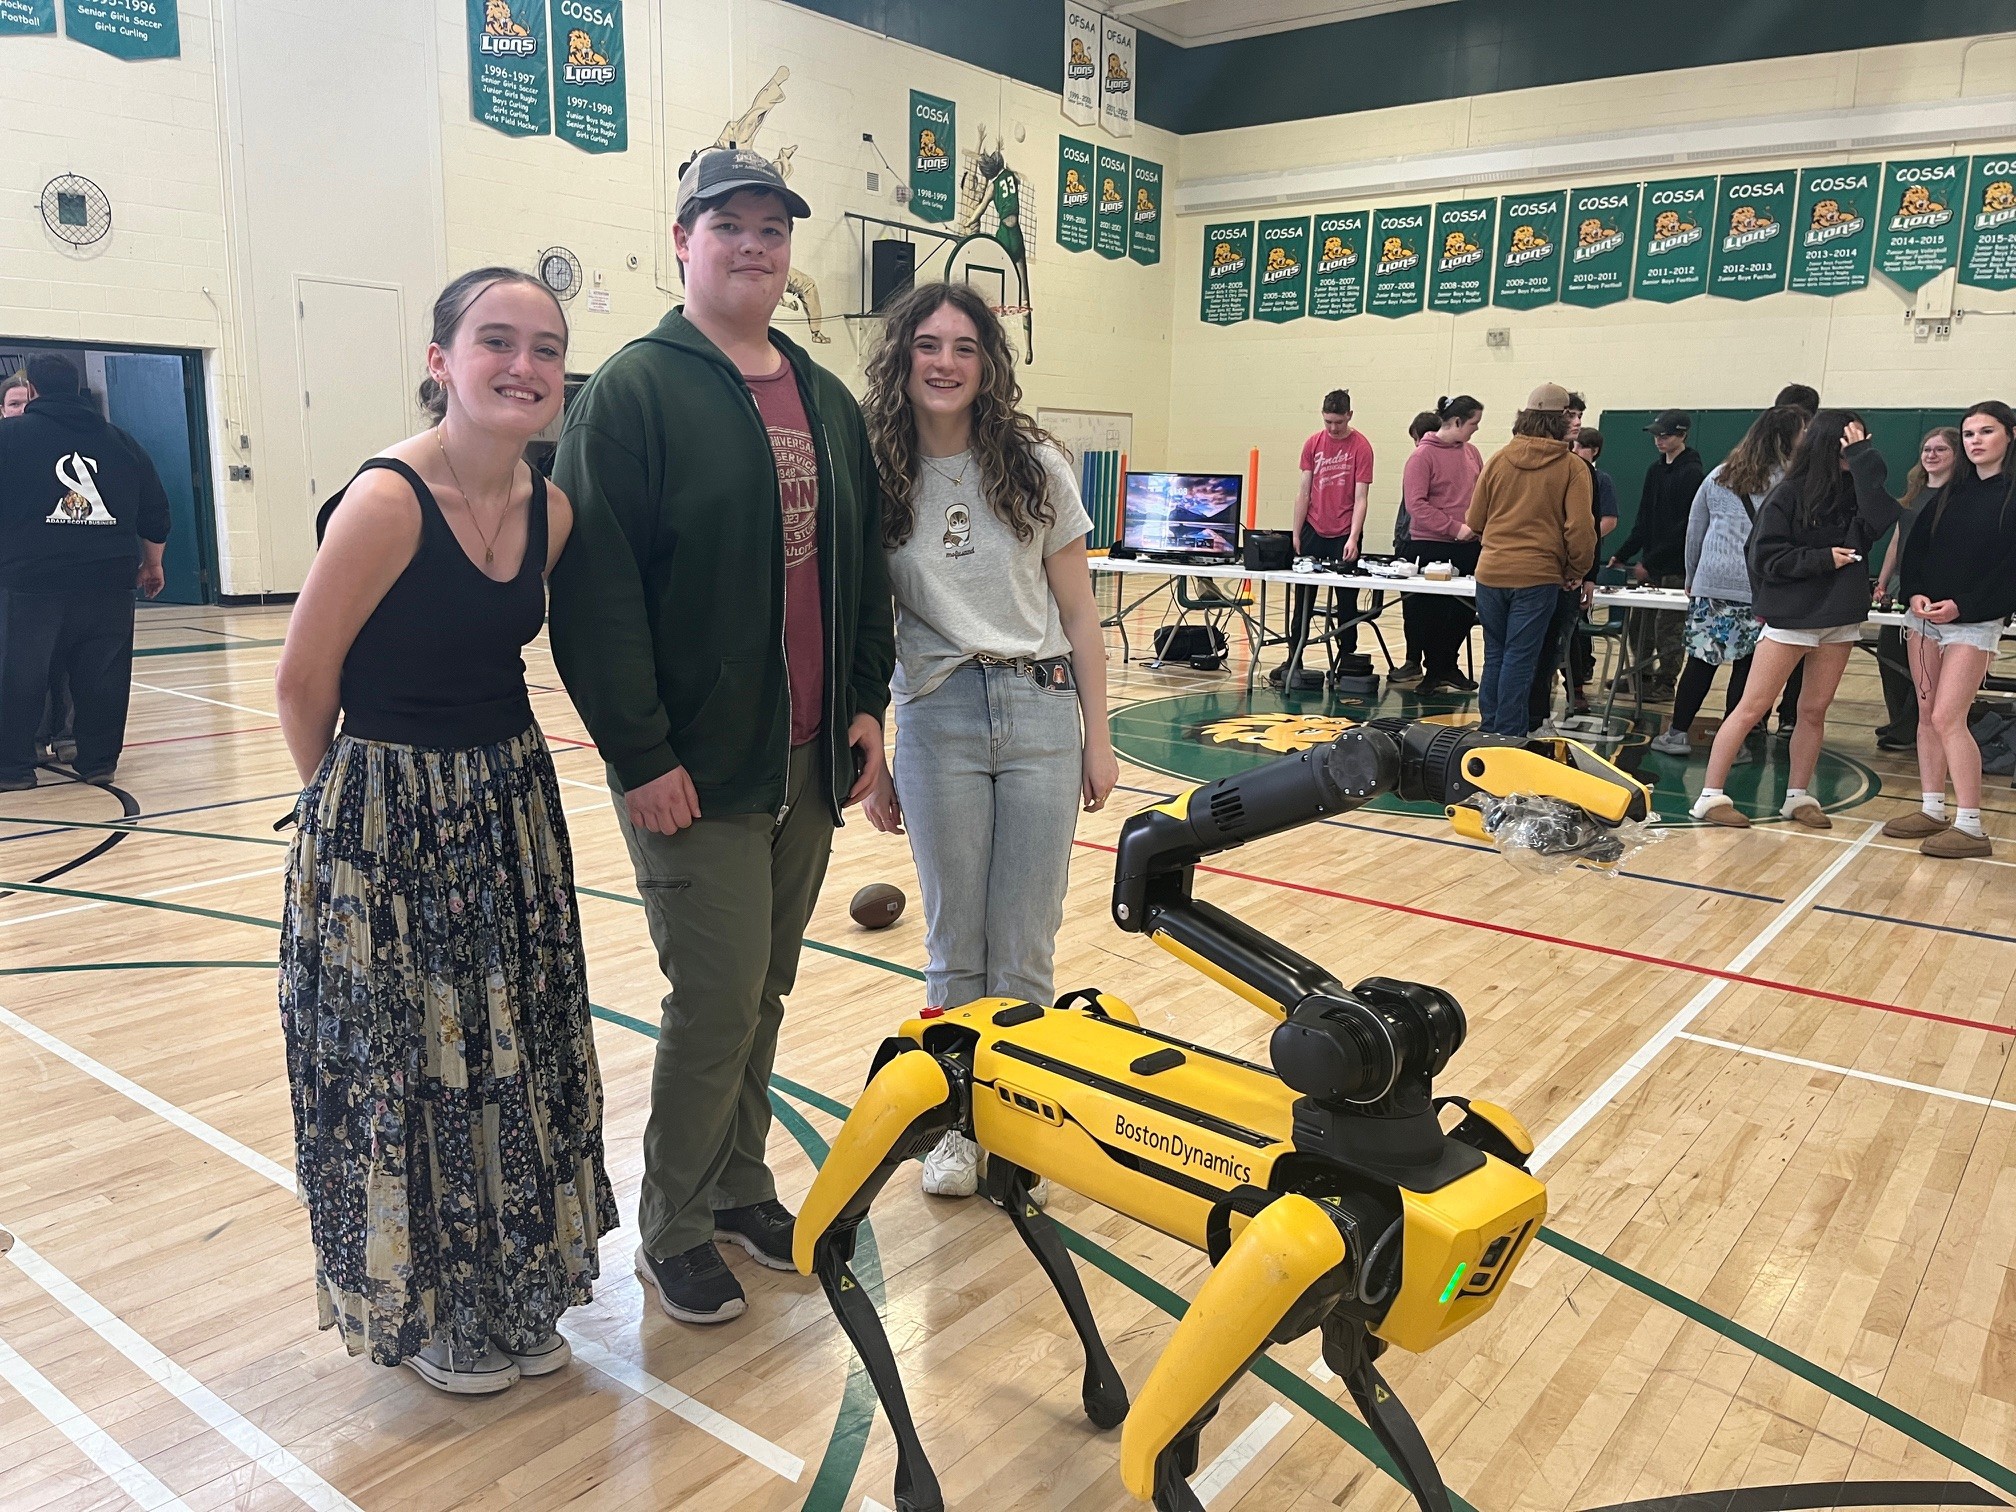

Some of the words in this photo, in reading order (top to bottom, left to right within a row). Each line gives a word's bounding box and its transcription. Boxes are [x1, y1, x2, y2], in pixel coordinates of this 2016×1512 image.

[2, 12, 40, 26] Football
[78, 5, 106, 18] Senior
[111, 12, 129, 23] Girls
[134, 17, 162, 29] Soccer
[561, 1, 614, 28] COSSA
[95, 22, 116, 33] Girls
[120, 27, 148, 41] Curling
[1069, 14, 1096, 33] OFSAA
[481, 35, 534, 55] Lions
[1107, 30, 1131, 48] OFSAA
[485, 64, 535, 84] 1996-1997
[565, 66, 613, 82] Lions
[1069, 64, 1094, 76] Lions
[481, 76, 500, 86] Senior
[503, 80, 516, 90] Girls
[519, 85, 538, 94] Soccer
[1106, 79, 1130, 90] Lions
[483, 85, 502, 95] Junior
[505, 90, 518, 99] Girls
[520, 94, 537, 105] Rugby
[493, 96, 507, 106] Boys
[509, 100, 528, 112] Curling
[567, 96, 613, 115] 1997-1998
[493, 106, 507, 115] Girls
[509, 109, 529, 121] Curling
[566, 111, 584, 120] Junior
[586, 115, 598, 125] Boys
[600, 119, 616, 130] Rugby
[916, 105, 949, 124] COSSA
[485, 113, 499, 122] Girls
[501, 117, 515, 126] Field
[517, 121, 538, 132] Hockey
[566, 120, 585, 129] Senior
[587, 124, 598, 133] Boys
[600, 128, 617, 138] Rugby
[576, 130, 589, 140] Girls
[917, 157, 948, 170] Lions
[1064, 148, 1089, 164] COSSA
[1101, 156, 1126, 173] COSSA
[1135, 168, 1158, 183] COSSA
[1896, 166, 1956, 182] COSSA
[1000, 176, 1016, 198] 33
[1729, 182, 1784, 198] COSSA
[1810, 176, 1868, 192] COSSA
[918, 189, 947, 201] 1998-1999
[1064, 193, 1088, 206] Lions
[1578, 195, 1628, 210] COSSA
[1652, 189, 1704, 204] COSSA
[1100, 201, 1123, 213] Lions
[1510, 202, 1557, 217] COSSA
[1135, 211, 1156, 222] Lions
[1381, 216, 1423, 230] COSSA
[1442, 209, 1486, 223] COSSA
[1891, 212, 1950, 229] Lions
[1321, 219, 1361, 231] COSSA
[1807, 220, 1862, 243] Lions
[1211, 228, 1247, 240] COSSA
[1265, 227, 1303, 240] COSSA
[1649, 229, 1700, 253] Lions
[1725, 224, 1778, 250] Lions
[1890, 236, 1944, 246] 2014-2015
[1506, 246, 1552, 265] Lions
[1575, 236, 1622, 260] Lions
[1806, 249, 1857, 259] 2013-2014
[1318, 255, 1357, 272] Lions
[1377, 256, 1418, 273] Lions
[1440, 250, 1482, 269] Lions
[1210, 260, 1244, 276] Lions
[1264, 265, 1299, 282] Lions
[1648, 266, 1694, 276] 2011-2012
[1723, 263, 1772, 273] 2012-2013
[1320, 278, 1355, 286] 2006-2007
[1440, 281, 1480, 290] 2008-2009
[1506, 277, 1548, 287] 2009-2010
[1573, 273, 1617, 282] 2010-2011
[1378, 282, 1415, 290] 2007-2008
[775, 453, 817, 475] SERVICE
